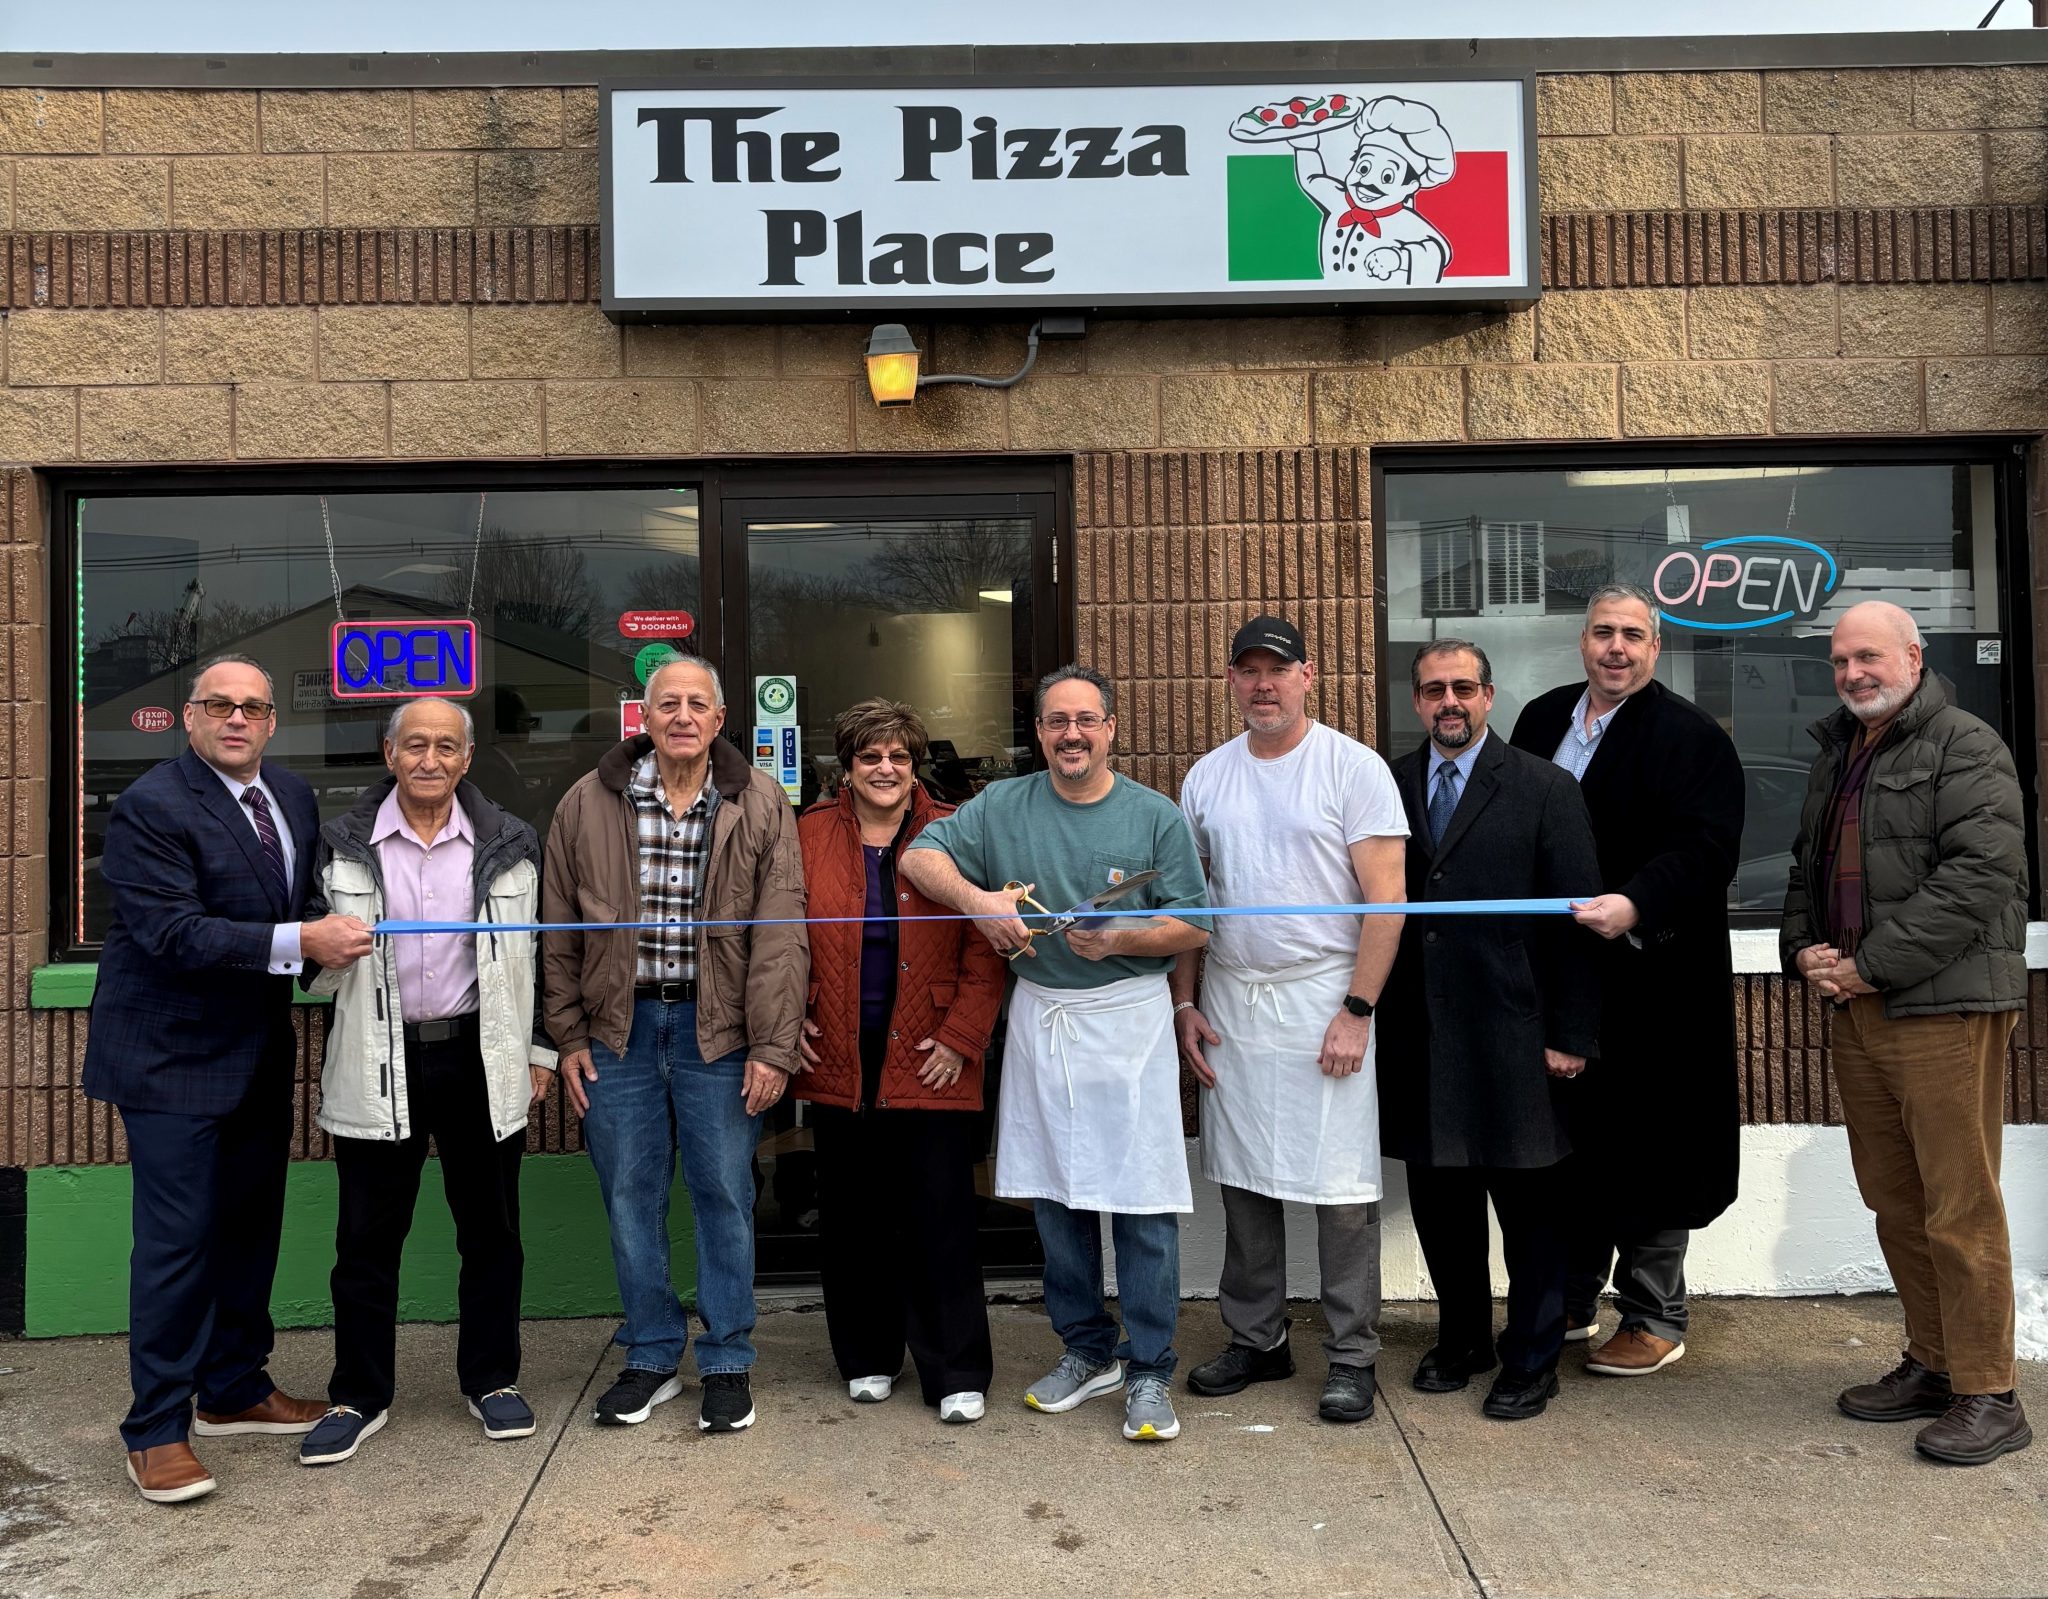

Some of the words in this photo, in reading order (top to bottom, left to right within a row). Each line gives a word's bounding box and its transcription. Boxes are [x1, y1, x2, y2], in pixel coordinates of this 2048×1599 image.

[637, 106, 842, 184] The
[893, 105, 1190, 182] Pizza
[757, 209, 1056, 286] Place
[1653, 551, 1823, 613] OPEN
[641, 623, 688, 631] DOORDASH
[337, 629, 472, 689] OPEN
[645, 657, 671, 668] Uber
[785, 730, 793, 765] PULL
